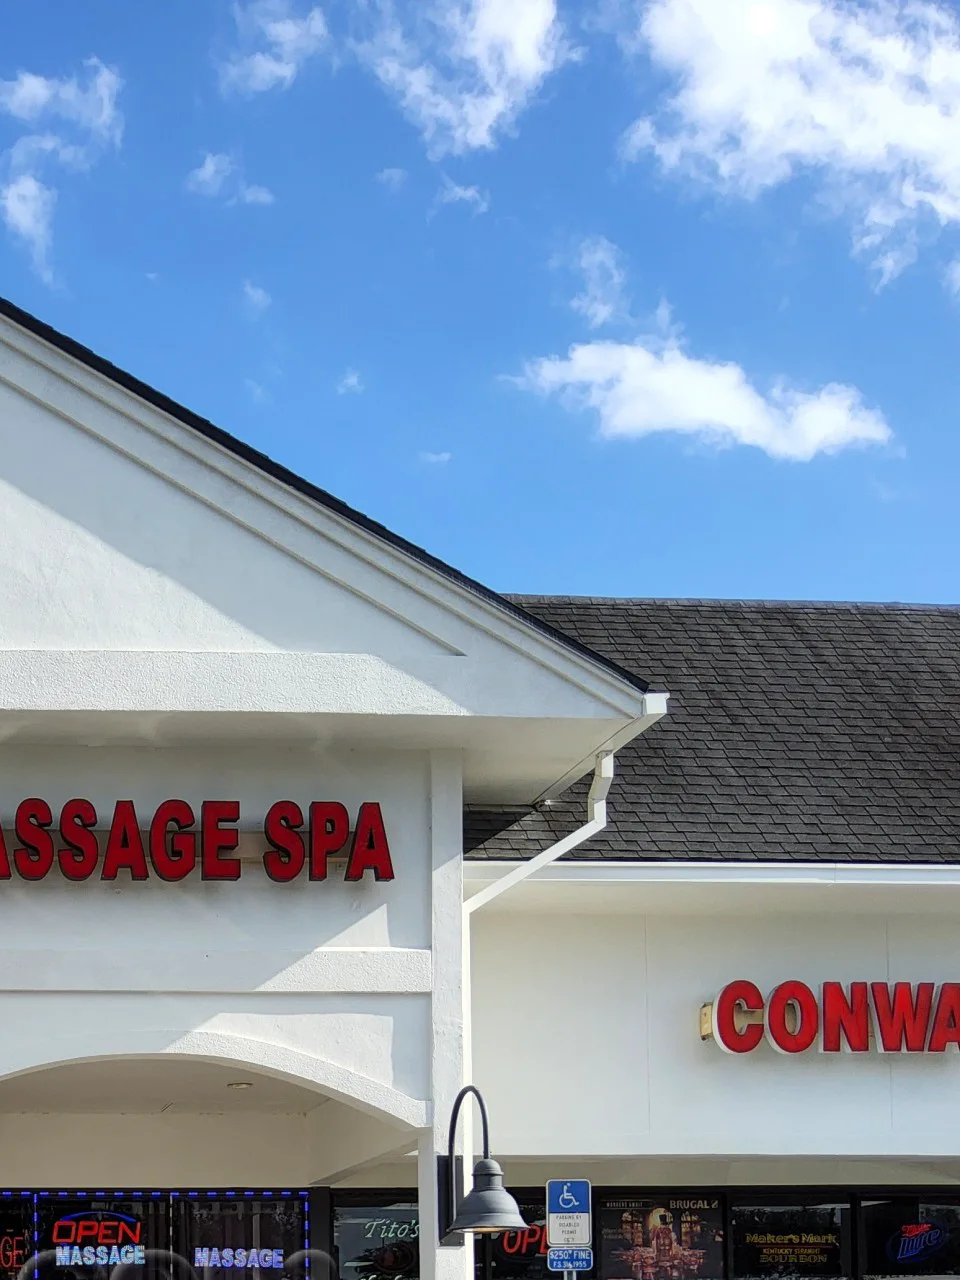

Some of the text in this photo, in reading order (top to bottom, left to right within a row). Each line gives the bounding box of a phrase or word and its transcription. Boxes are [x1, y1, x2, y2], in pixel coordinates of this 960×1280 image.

[262, 800, 395, 882] SPA
[713, 980, 960, 1054] CONWA
[670, 1200, 710, 1209] BRUGAL
[52, 1221, 140, 1244] OPEN
[365, 1219, 420, 1238] Tito's
[745, 1233, 837, 1244] Maker's Mark
[55, 1245, 147, 1266] MASSAGE
[194, 1247, 284, 1269] MASSAGE
[573, 1250, 590, 1259] FINE
[760, 1255, 827, 1263] BOURBON
